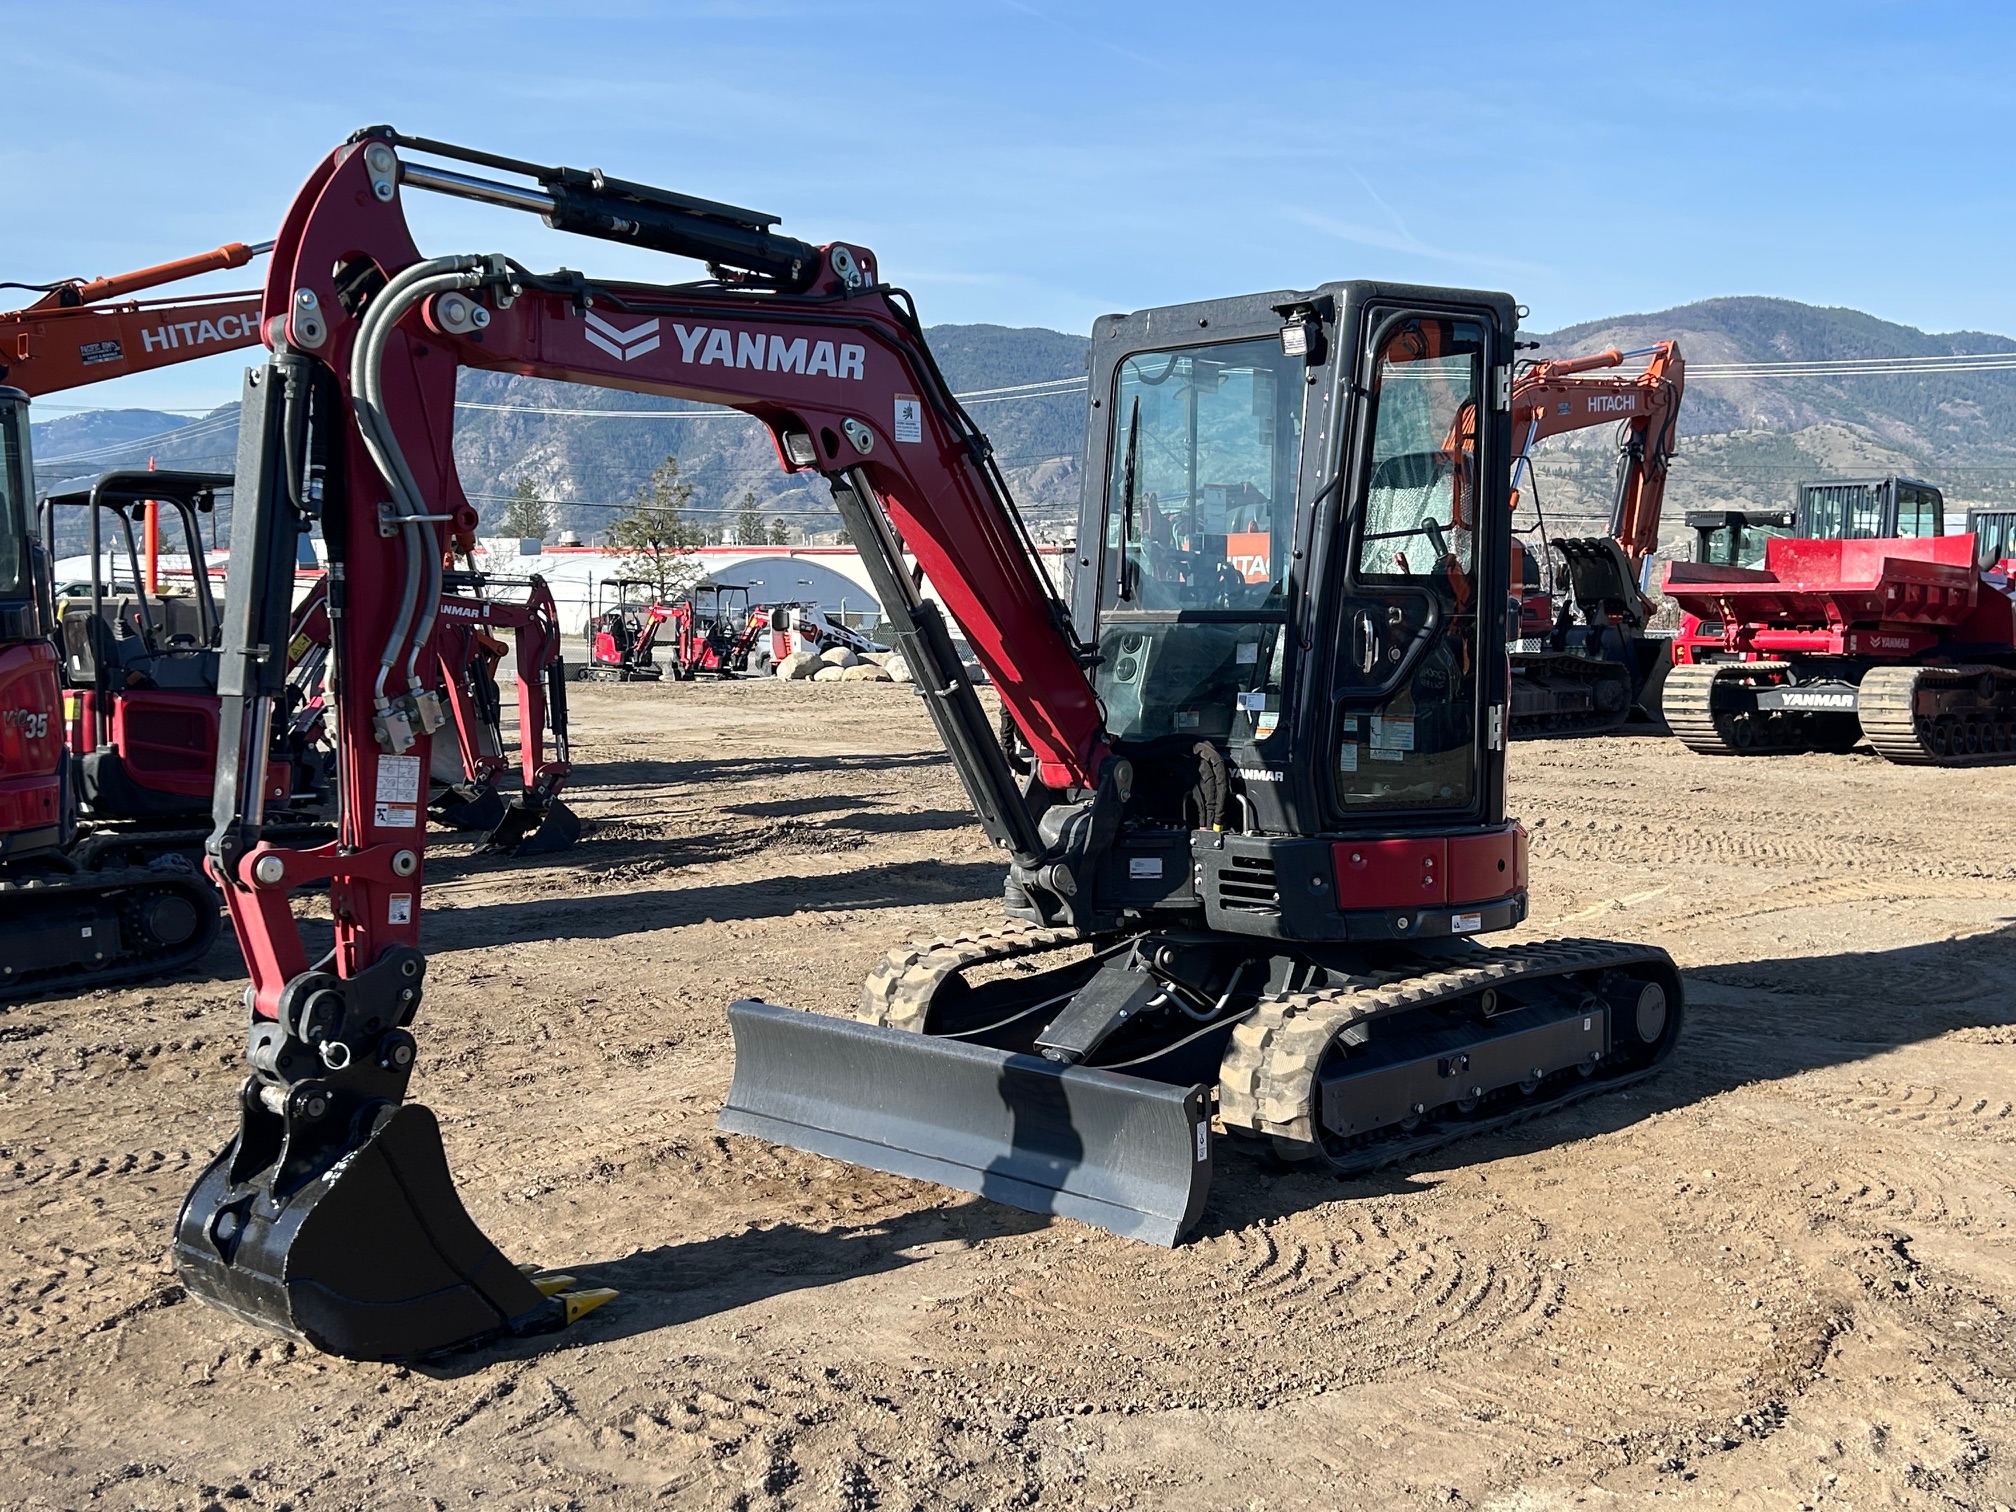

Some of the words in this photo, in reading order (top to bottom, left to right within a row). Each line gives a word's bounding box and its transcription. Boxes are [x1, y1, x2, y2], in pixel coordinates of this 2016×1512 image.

[673, 324, 866, 381] YANMAR
[1588, 395, 1635, 412] HITACHI
[1882, 637, 1909, 649] YANMAR
[1782, 694, 1854, 707] YANMAR
[1229, 768, 1284, 782] YANMAR
